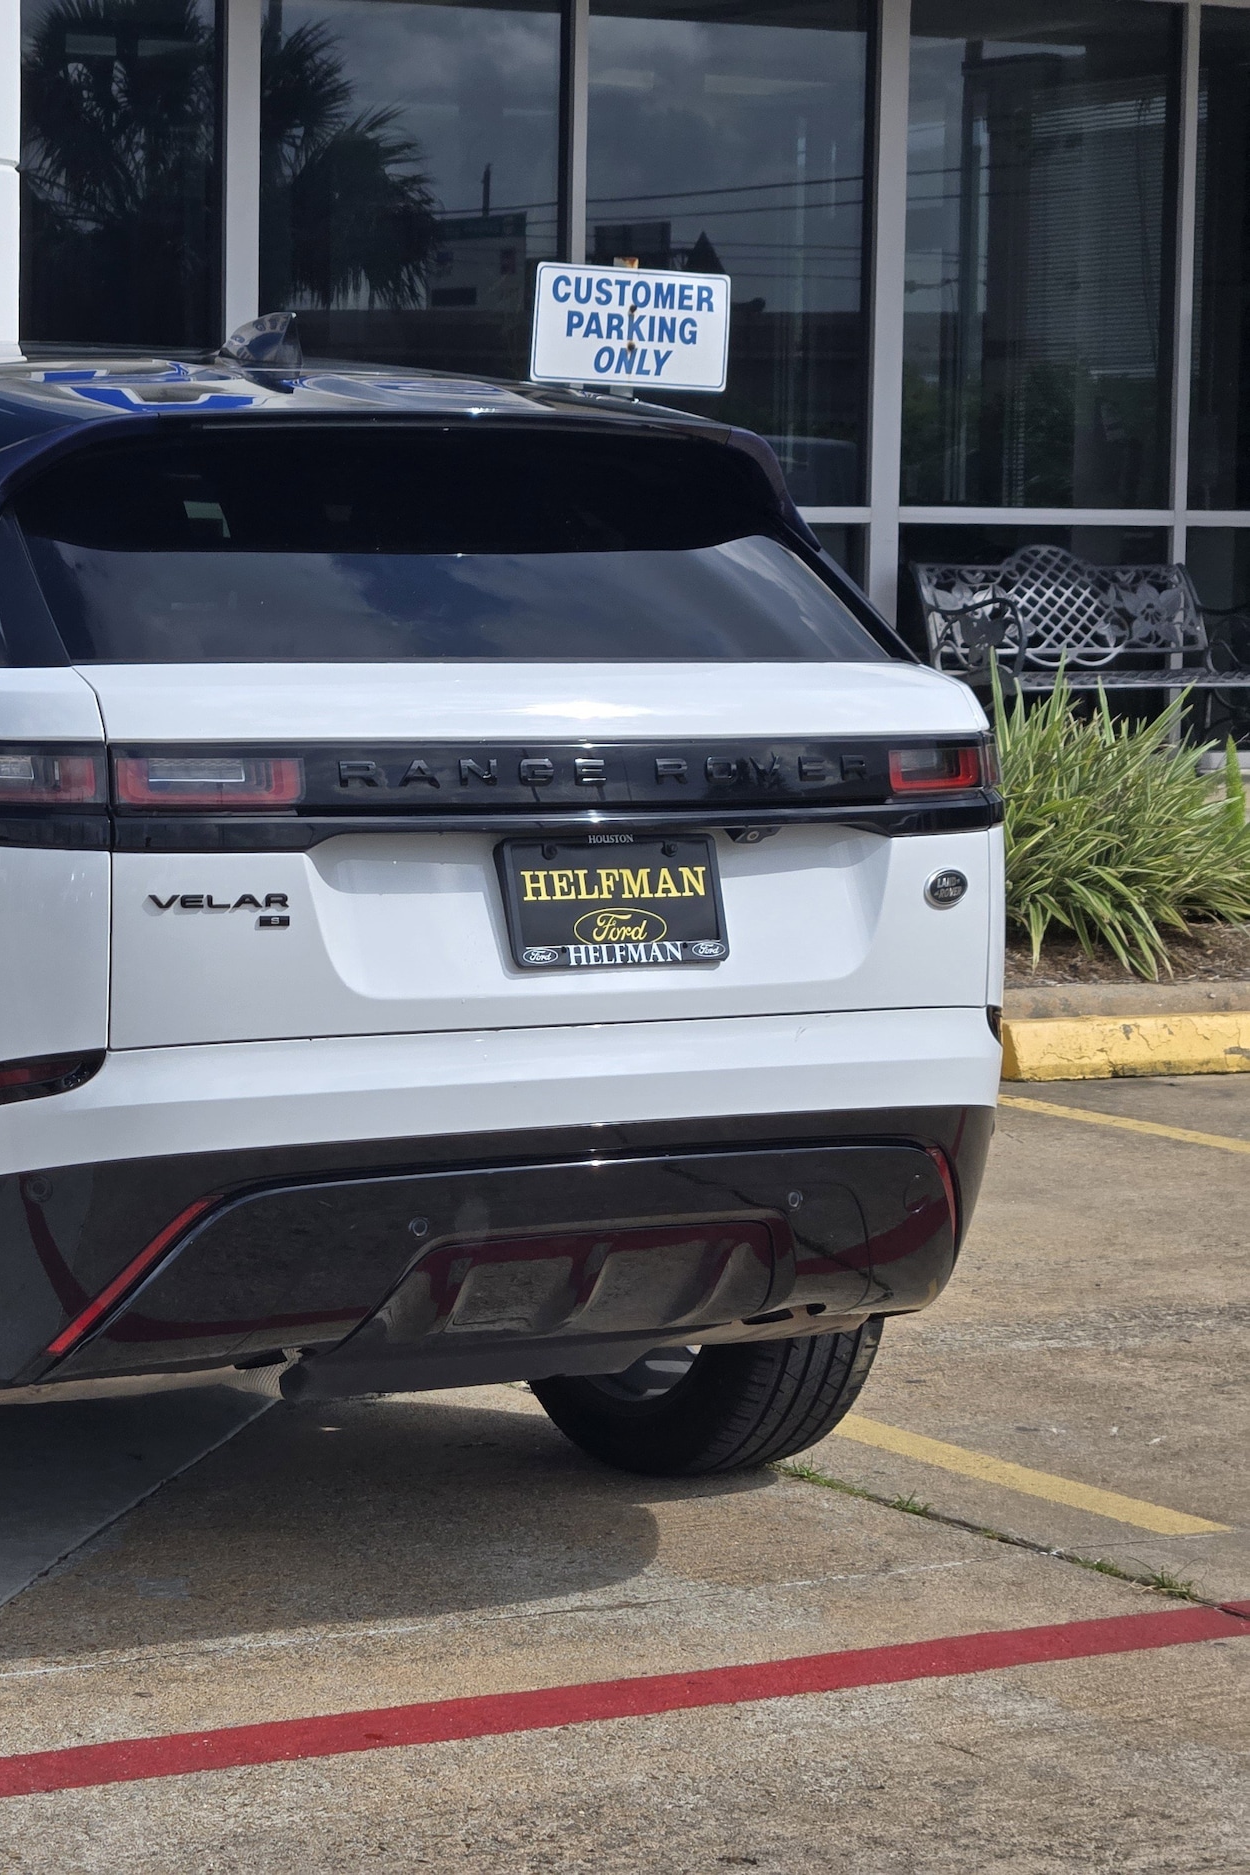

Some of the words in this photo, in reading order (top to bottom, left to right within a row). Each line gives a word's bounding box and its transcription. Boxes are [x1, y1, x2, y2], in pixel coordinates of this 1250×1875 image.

[552, 275, 714, 312] CUSTOMER
[566, 310, 698, 345] PARKING
[594, 346, 673, 376] ONLY
[338, 758, 607, 789] RANGE
[654, 753, 867, 787] ROVER
[588, 834, 634, 844] HOUSTON
[520, 866, 706, 901] HELFMAN
[148, 893, 289, 909] VELAR
[592, 912, 648, 942] Ford
[529, 951, 552, 962] Ford
[566, 941, 683, 966] HELFMAN
[698, 942, 720, 955] Ford
